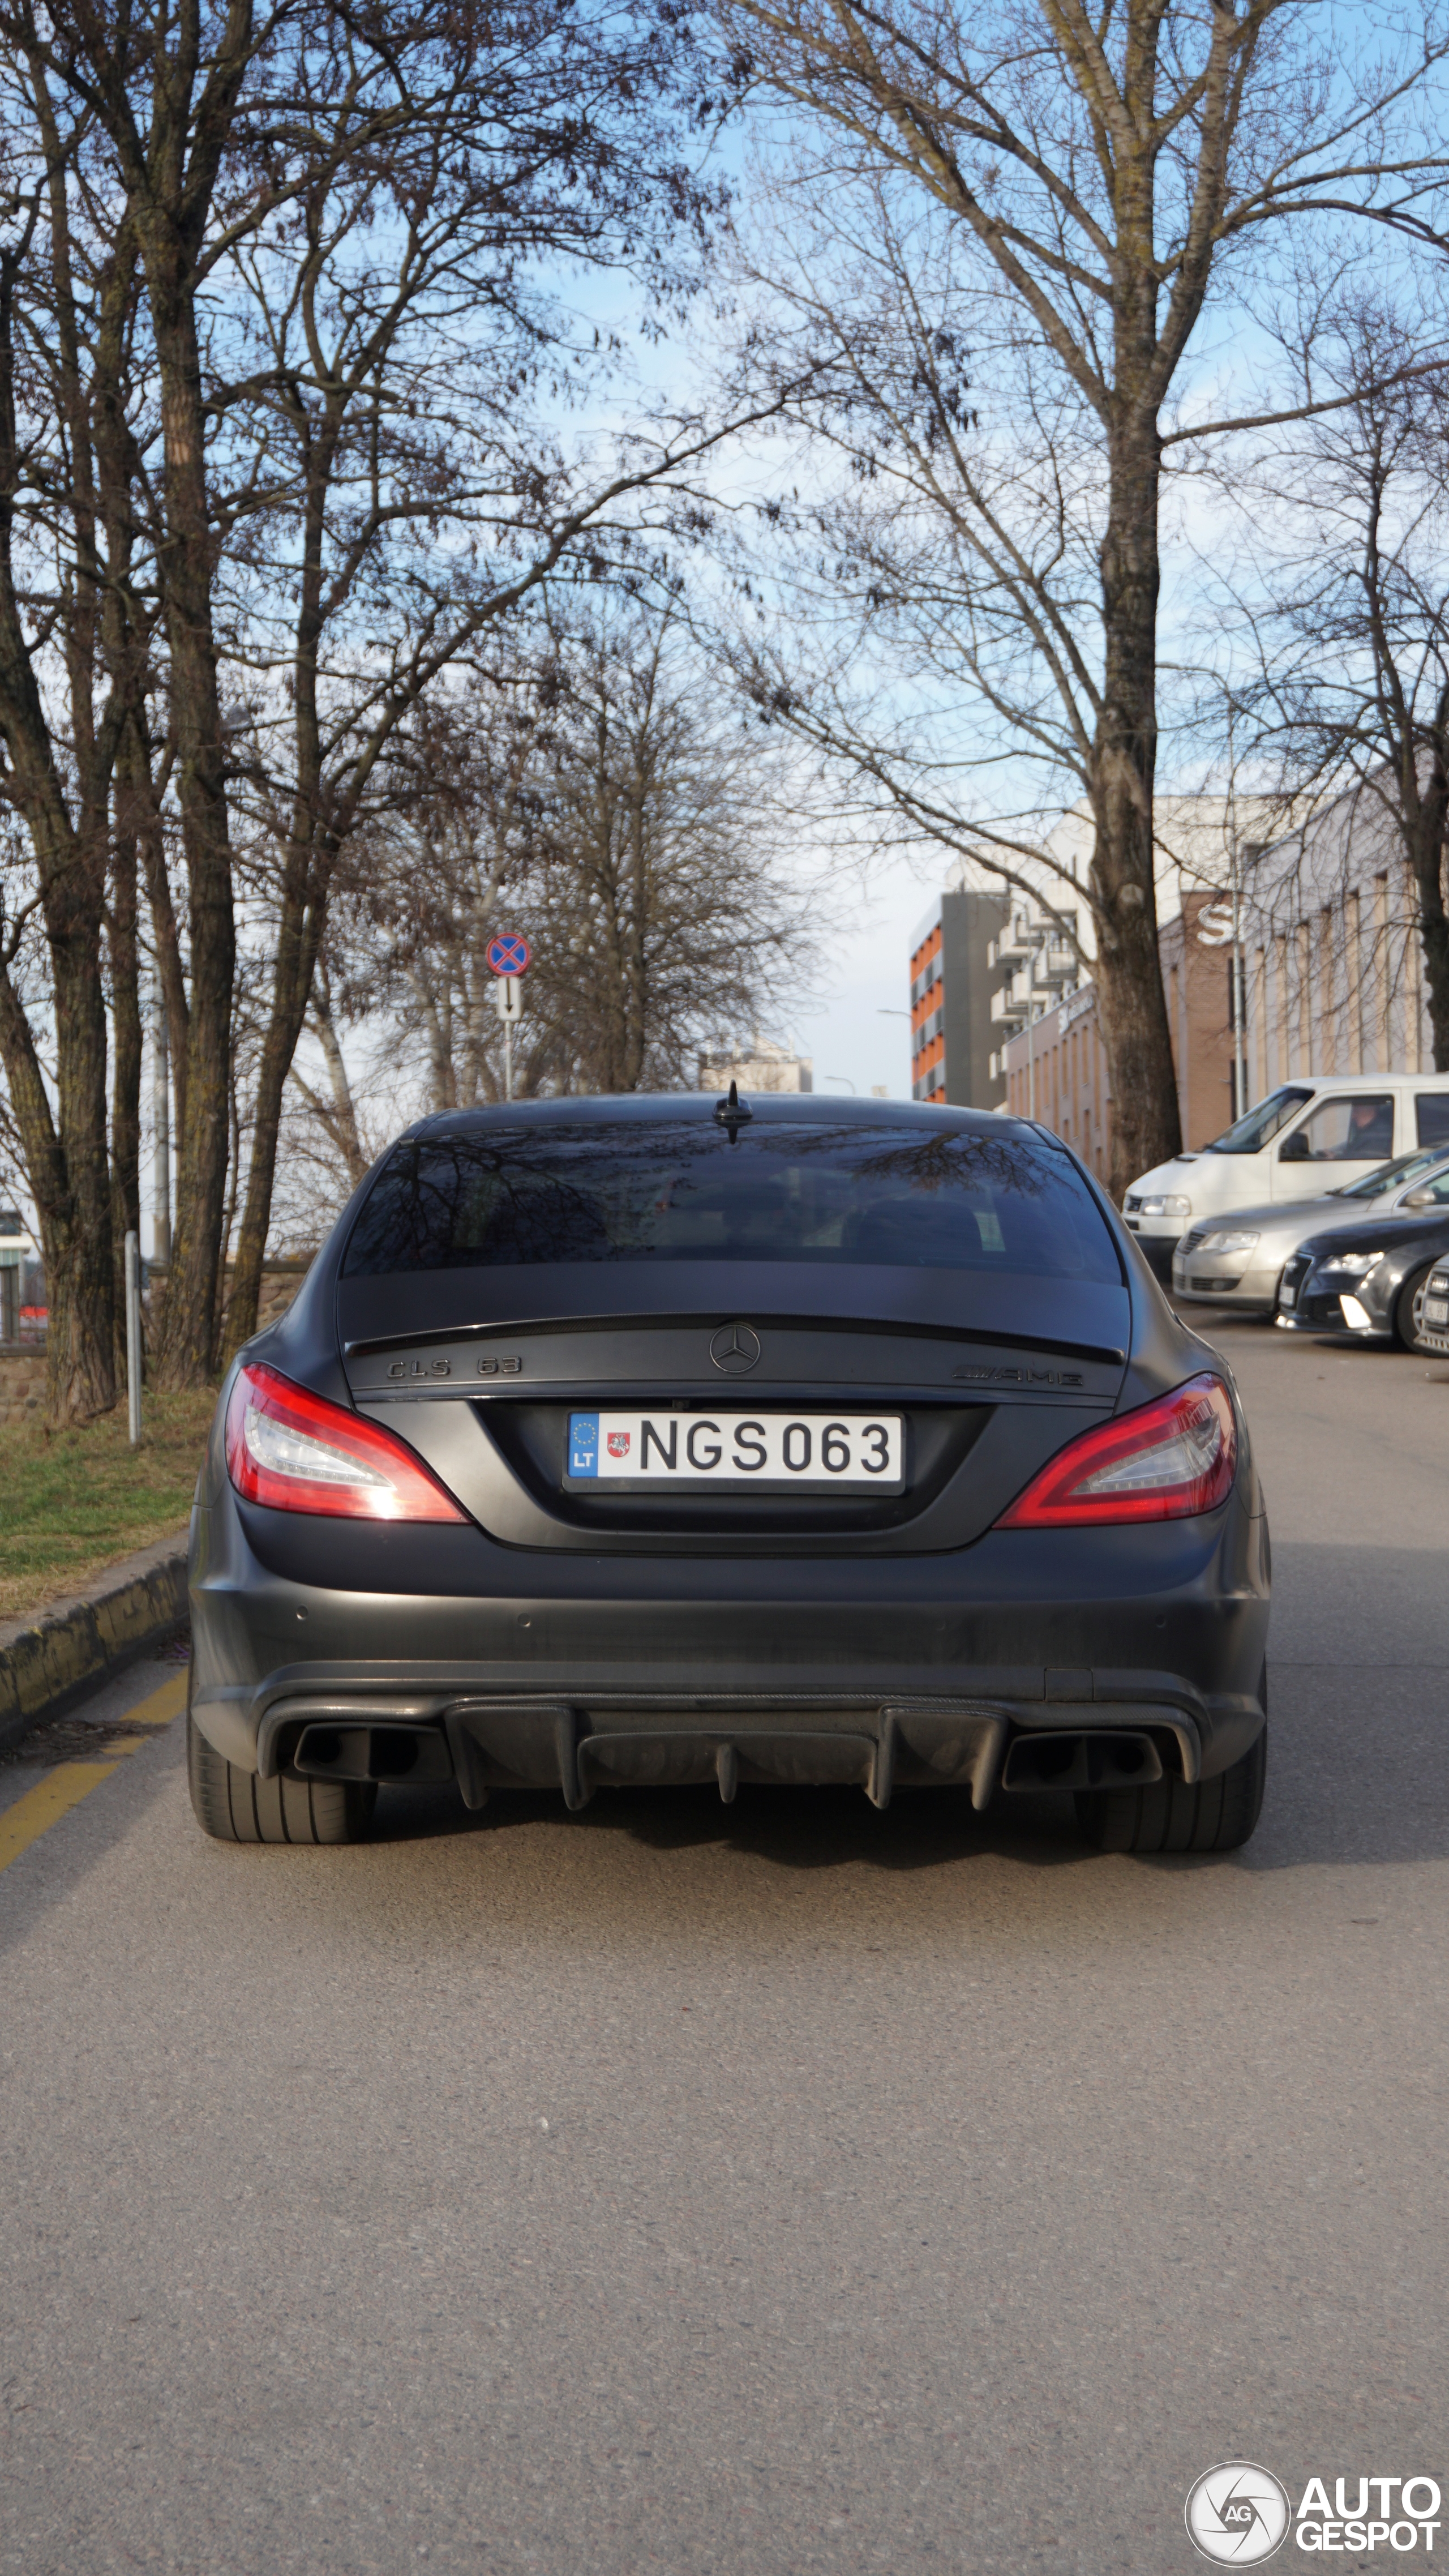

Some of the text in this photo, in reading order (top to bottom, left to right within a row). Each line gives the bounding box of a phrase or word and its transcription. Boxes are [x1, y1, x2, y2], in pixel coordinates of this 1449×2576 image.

[387, 1356, 522, 1378] CLS 63
[994, 1367, 1083, 1385] AMG
[573, 1453, 594, 1467] LT
